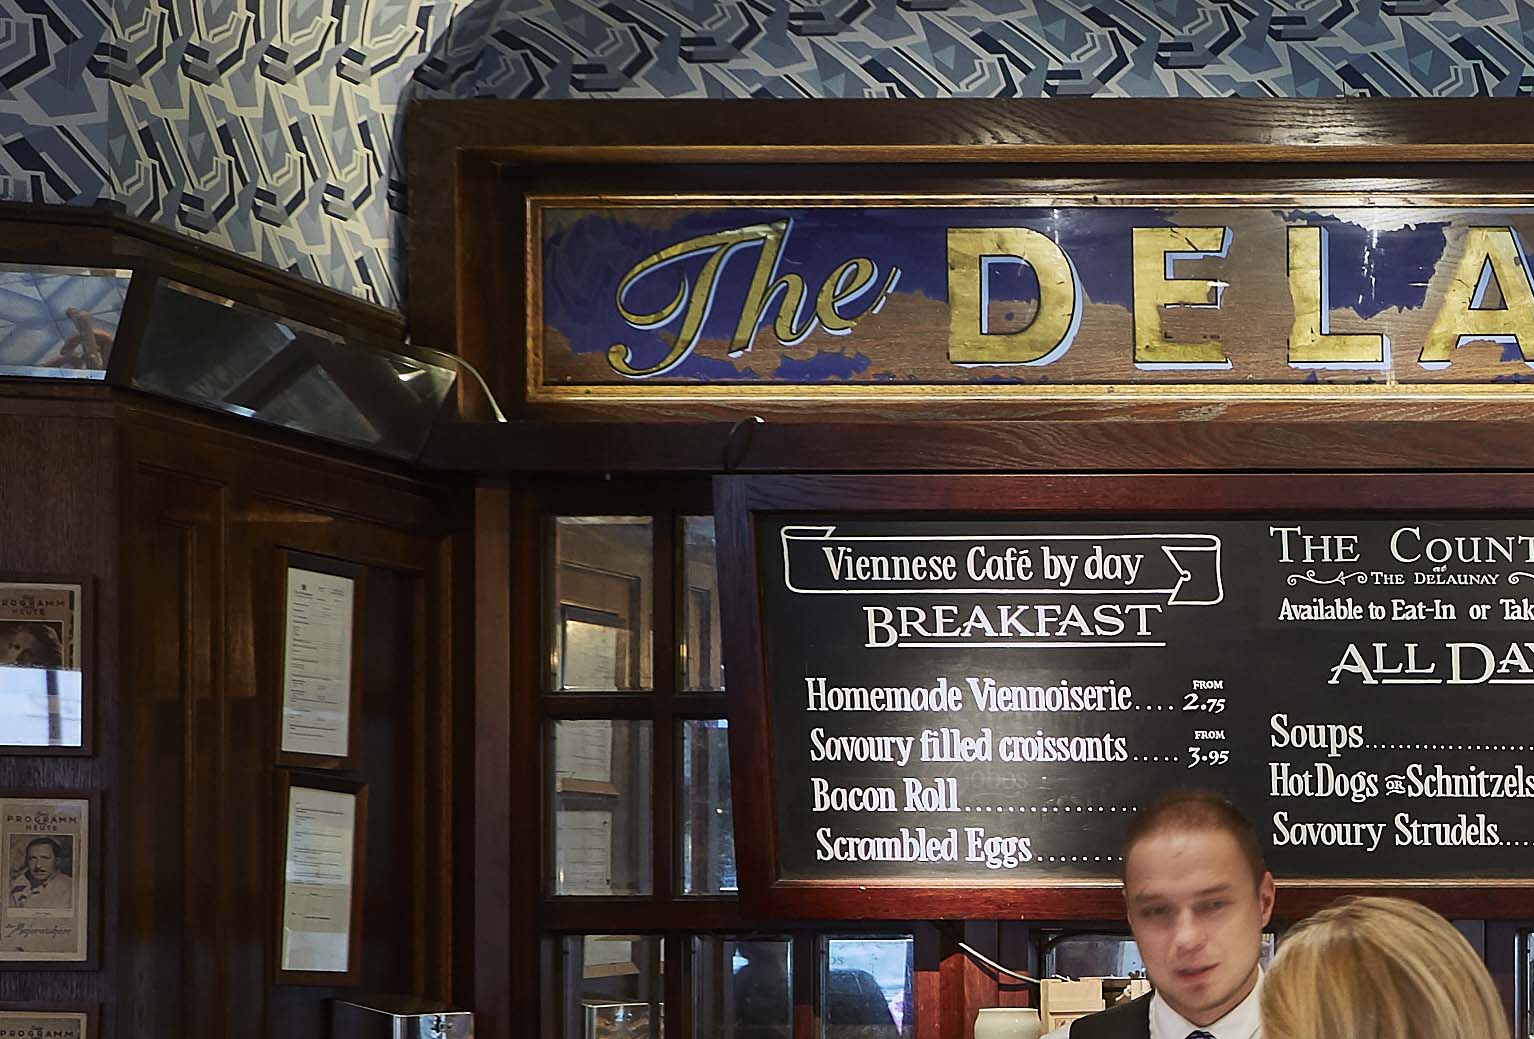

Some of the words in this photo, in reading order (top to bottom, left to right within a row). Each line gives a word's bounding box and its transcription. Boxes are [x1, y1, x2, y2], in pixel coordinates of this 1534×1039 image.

[607, 217, 902, 379] The
[1269, 525, 1361, 563] THE
[821, 546, 957, 581] Viennese
[966, 545, 1034, 581] Café
[1040, 545, 1079, 588] by
[1083, 545, 1145, 586] day
[1370, 571, 1406, 585] THE
[1413, 571, 1500, 585] DELAUNAY
[862, 604, 1167, 648] BREAKFAST
[1277, 597, 1364, 621] Available
[1367, 601, 1386, 621] to
[1390, 598, 1457, 621] Eat-In
[1468, 604, 1492, 620] or
[1327, 642, 1443, 685] ALL
[804, 677, 963, 712] Homemade
[967, 677, 1132, 711] Viennoiserie
[1182, 692, 1226, 714] 2.75
[810, 727, 918, 767] Savoury
[920, 728, 992, 762] filled
[999, 730, 1128, 762] croissants
[1187, 746, 1230, 769] 3.95
[1270, 713, 1364, 758] Soups
[810, 777, 899, 812] Bacon
[903, 778, 961, 812] Roll
[816, 827, 958, 863] Scrambled
[965, 828, 1032, 869] Eggs
[1272, 810, 1387, 852] Savoury
[1394, 812, 1501, 847] Strudels
